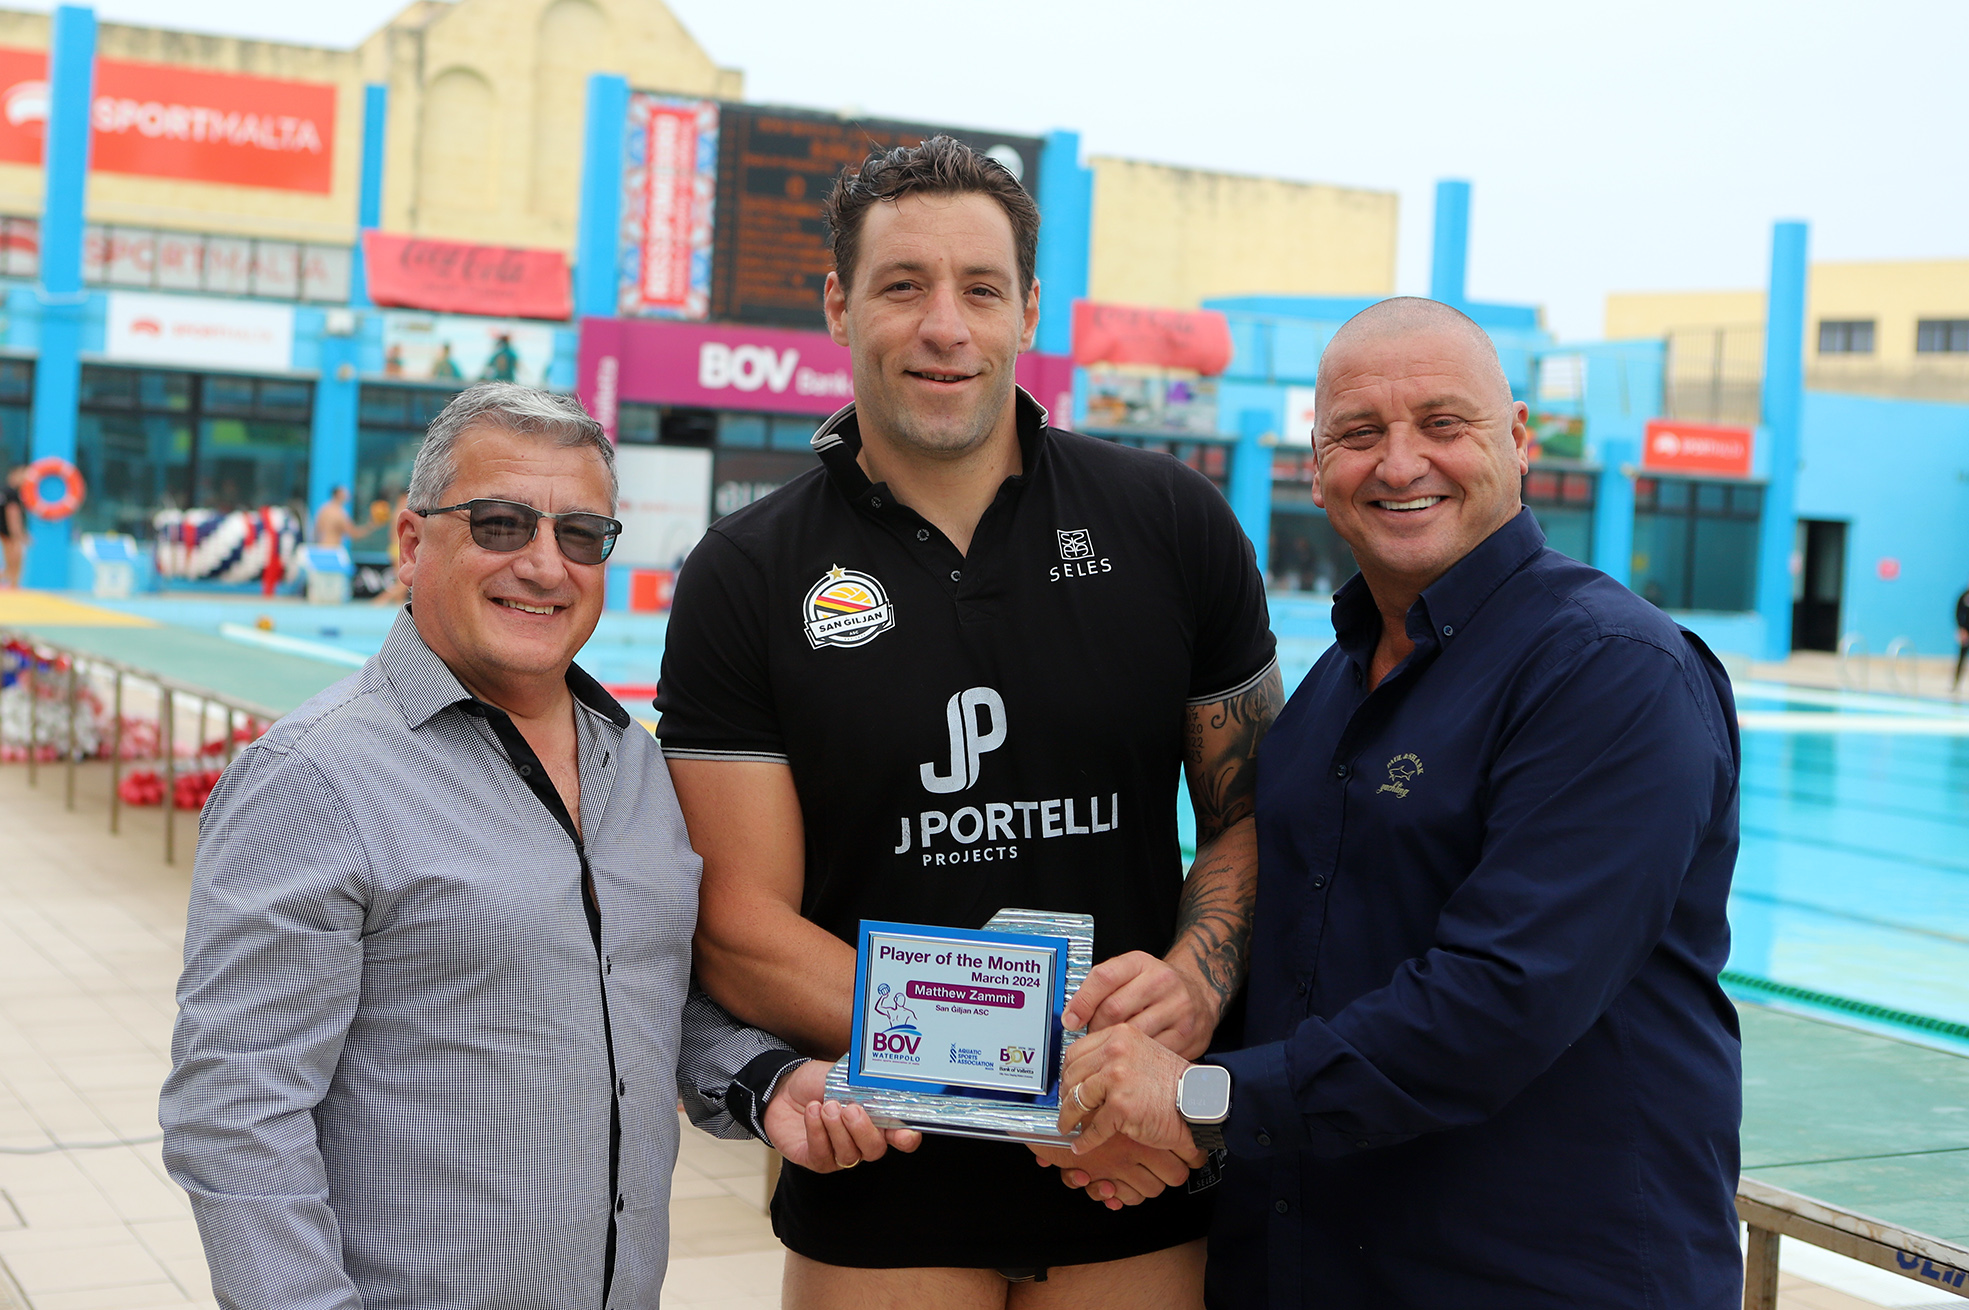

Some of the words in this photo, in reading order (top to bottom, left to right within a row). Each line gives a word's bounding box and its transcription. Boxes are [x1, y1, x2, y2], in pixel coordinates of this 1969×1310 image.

[92, 96, 322, 154] SPORTMALTA
[698, 341, 800, 393] BOV
[1049, 558, 1112, 582] SELES
[819, 620, 842, 633] SAN
[894, 817, 911, 855] J
[920, 792, 1119, 848] PORTELLI
[922, 846, 1018, 867] PROJECTS
[879, 945, 931, 965] Player
[935, 952, 952, 966] of
[956, 953, 983, 968] the
[988, 956, 1041, 974] Month
[971, 972, 1009, 985] March
[1012, 975, 1041, 988] 2024
[914, 984, 966, 999] Matthew
[969, 989, 1015, 1004] Zammit
[935, 1004, 950, 1012] San
[973, 1008, 990, 1016] ASC
[873, 1032, 922, 1055] BOV
[958, 1048, 982, 1056] AQUATIC
[872, 1052, 921, 1063] WATERPOLO
